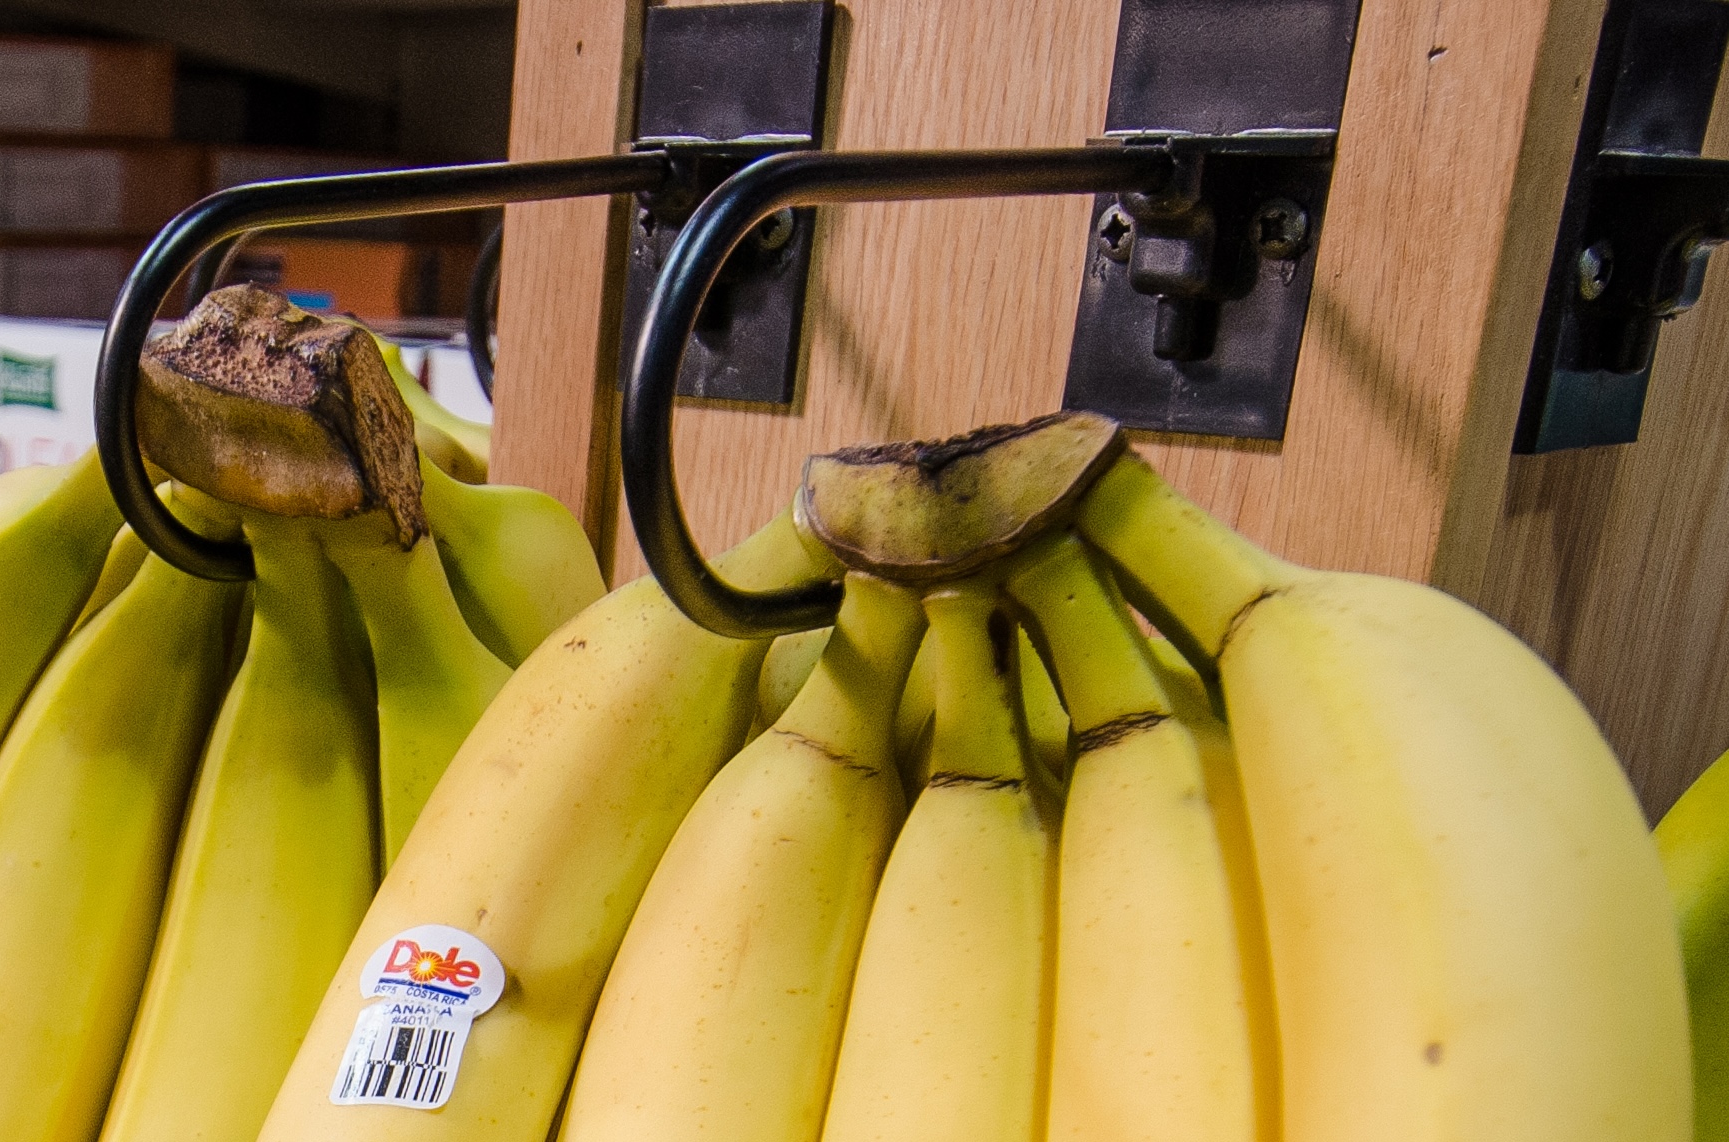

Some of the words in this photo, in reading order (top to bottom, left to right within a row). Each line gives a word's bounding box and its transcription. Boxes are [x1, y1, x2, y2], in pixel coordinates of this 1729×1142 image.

[382, 939, 481, 988] Dole
[406, 987, 439, 1002] COSTA
[384, 1004, 454, 1017] ANAA
[391, 1015, 430, 1026] #4011
